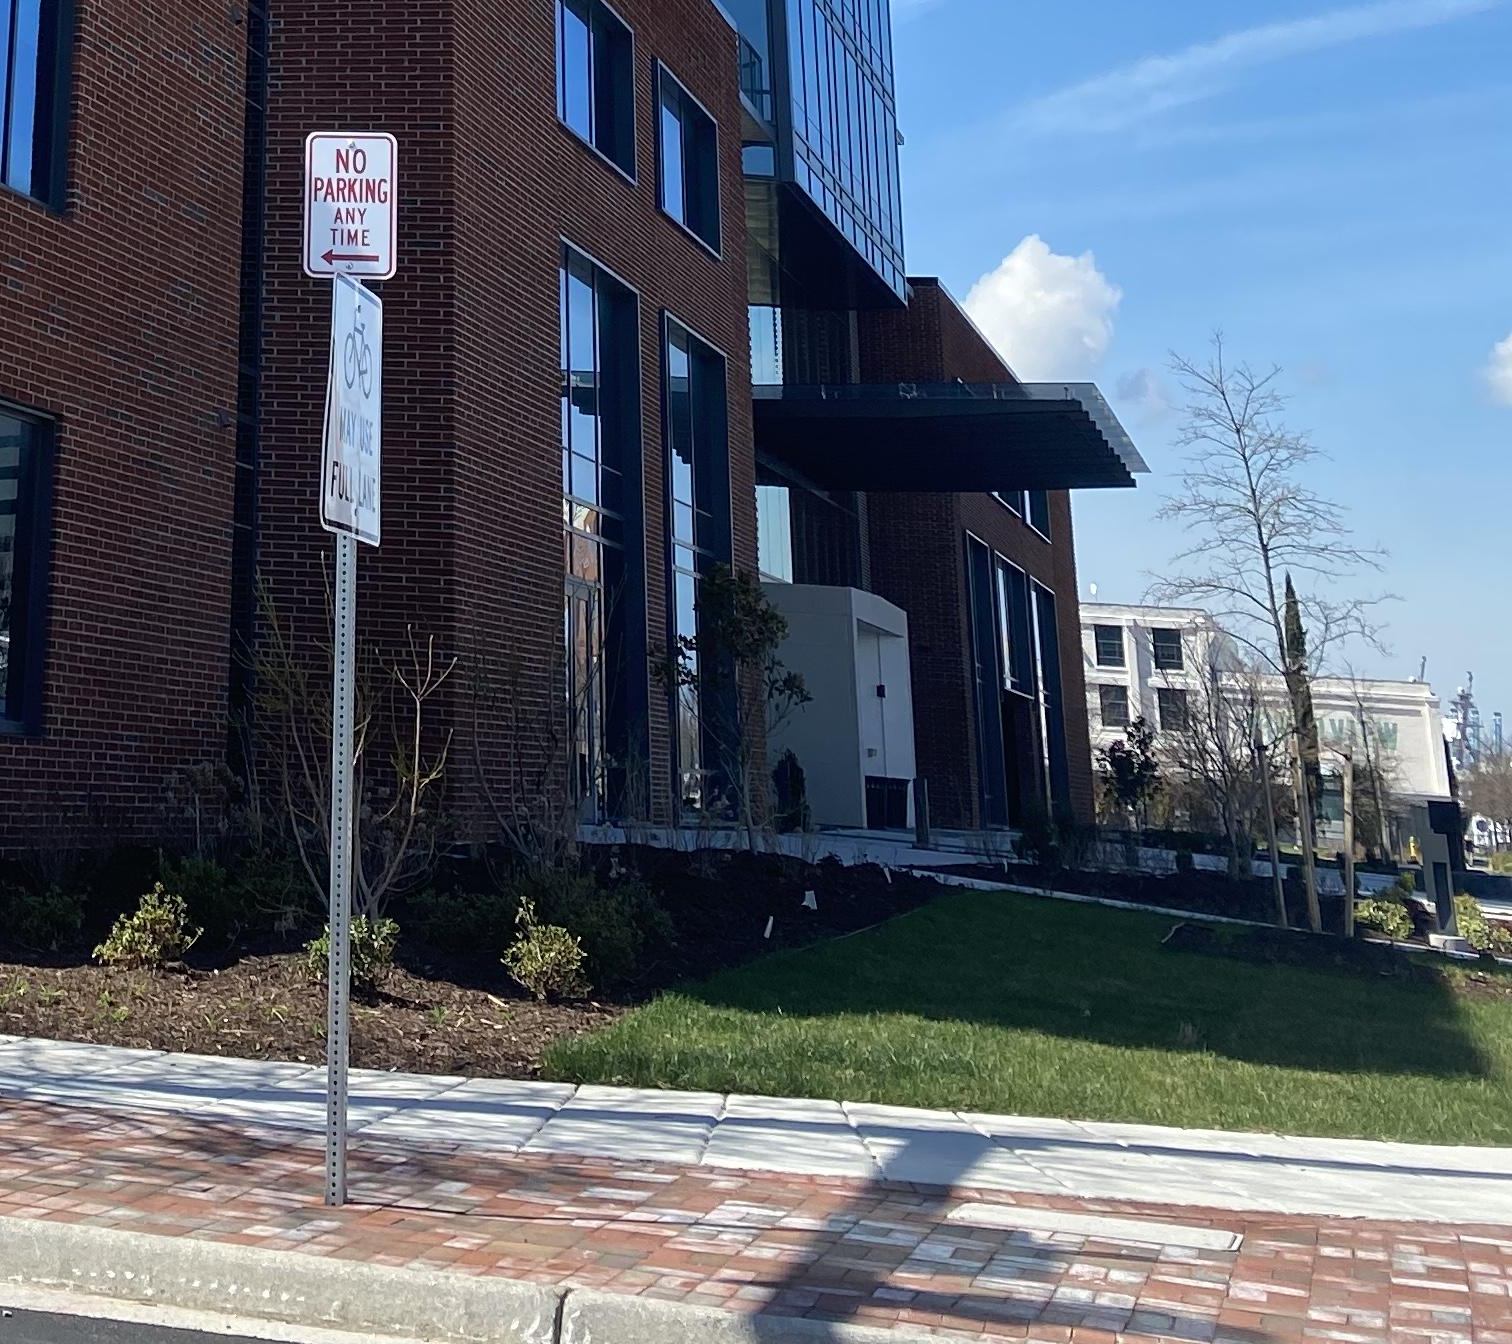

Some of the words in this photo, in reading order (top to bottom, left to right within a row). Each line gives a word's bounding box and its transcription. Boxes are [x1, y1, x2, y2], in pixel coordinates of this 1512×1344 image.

[335, 148, 367, 174] NO
[313, 177, 388, 203] PARKING
[334, 207, 367, 225] ANY
[330, 228, 370, 246] TIME
[339, 407, 357, 448] MAY
[359, 415, 373, 457] USE
[330, 460, 354, 503] FULL
[358, 466, 376, 513] LANE
